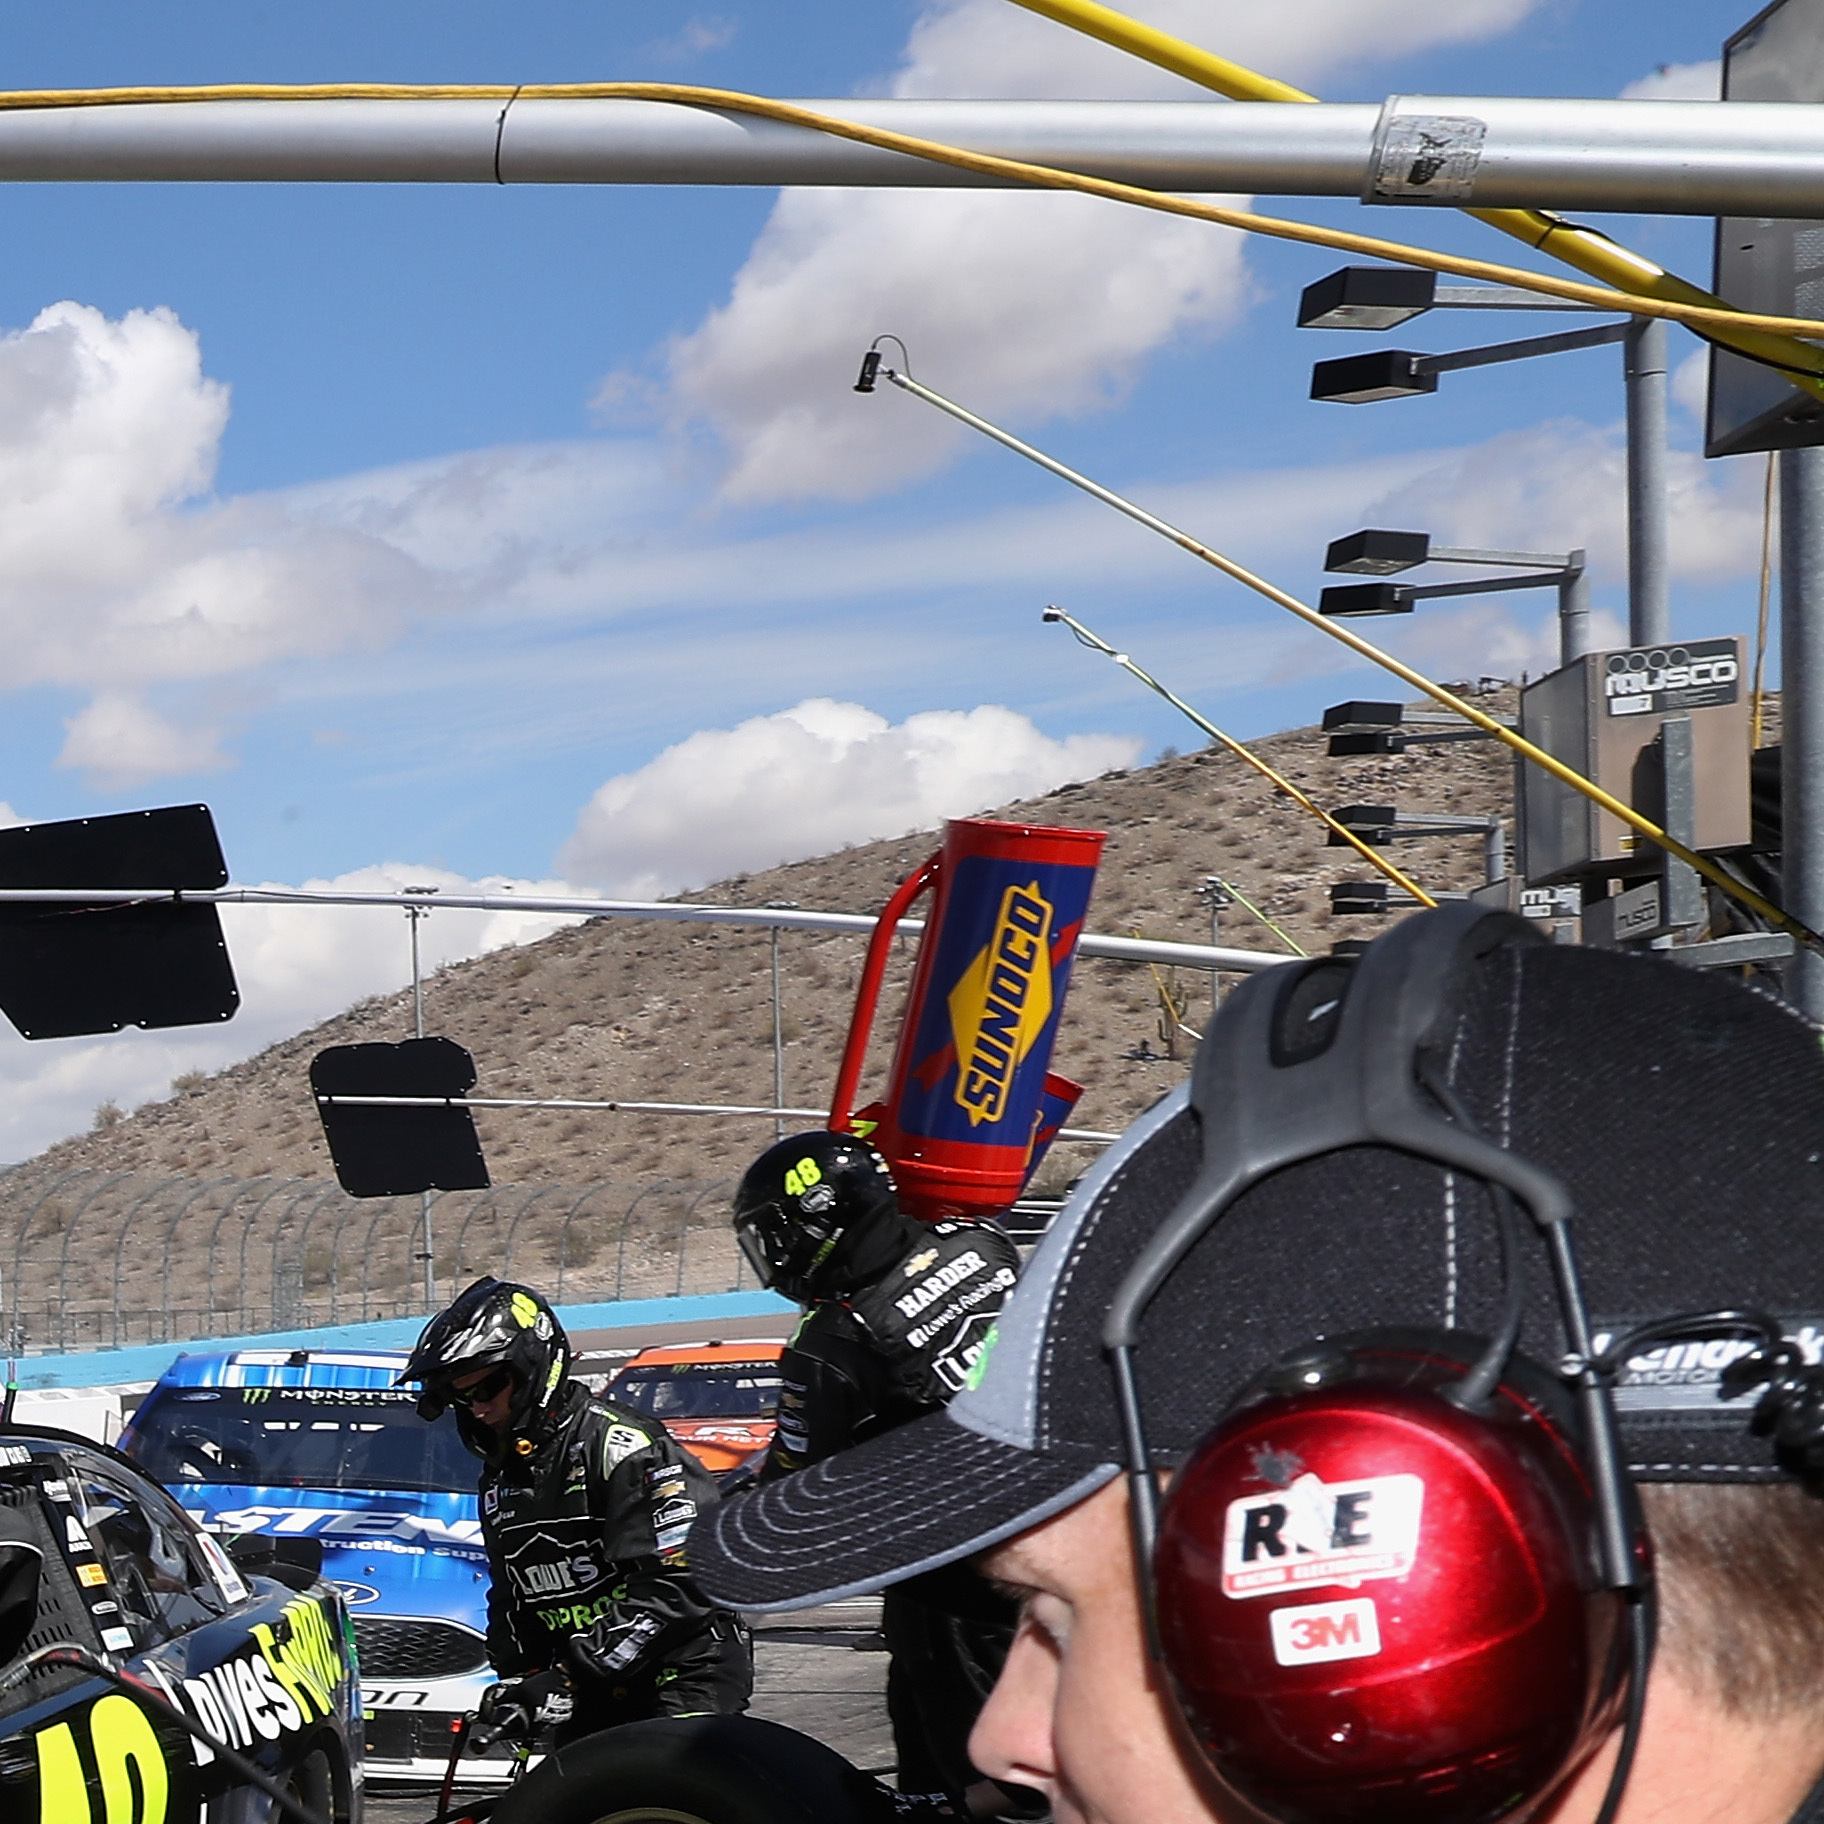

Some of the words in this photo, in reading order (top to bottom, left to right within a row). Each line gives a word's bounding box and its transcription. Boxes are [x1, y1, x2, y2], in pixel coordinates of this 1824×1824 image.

[964, 890, 1046, 1117] SUNOCO
[784, 1157, 822, 1196] 48
[895, 1251, 987, 1319] HARDER
[510, 1291, 540, 1330] 48
[320, 1539, 426, 1556] truction
[1290, 1612, 1361, 1651] 3M
